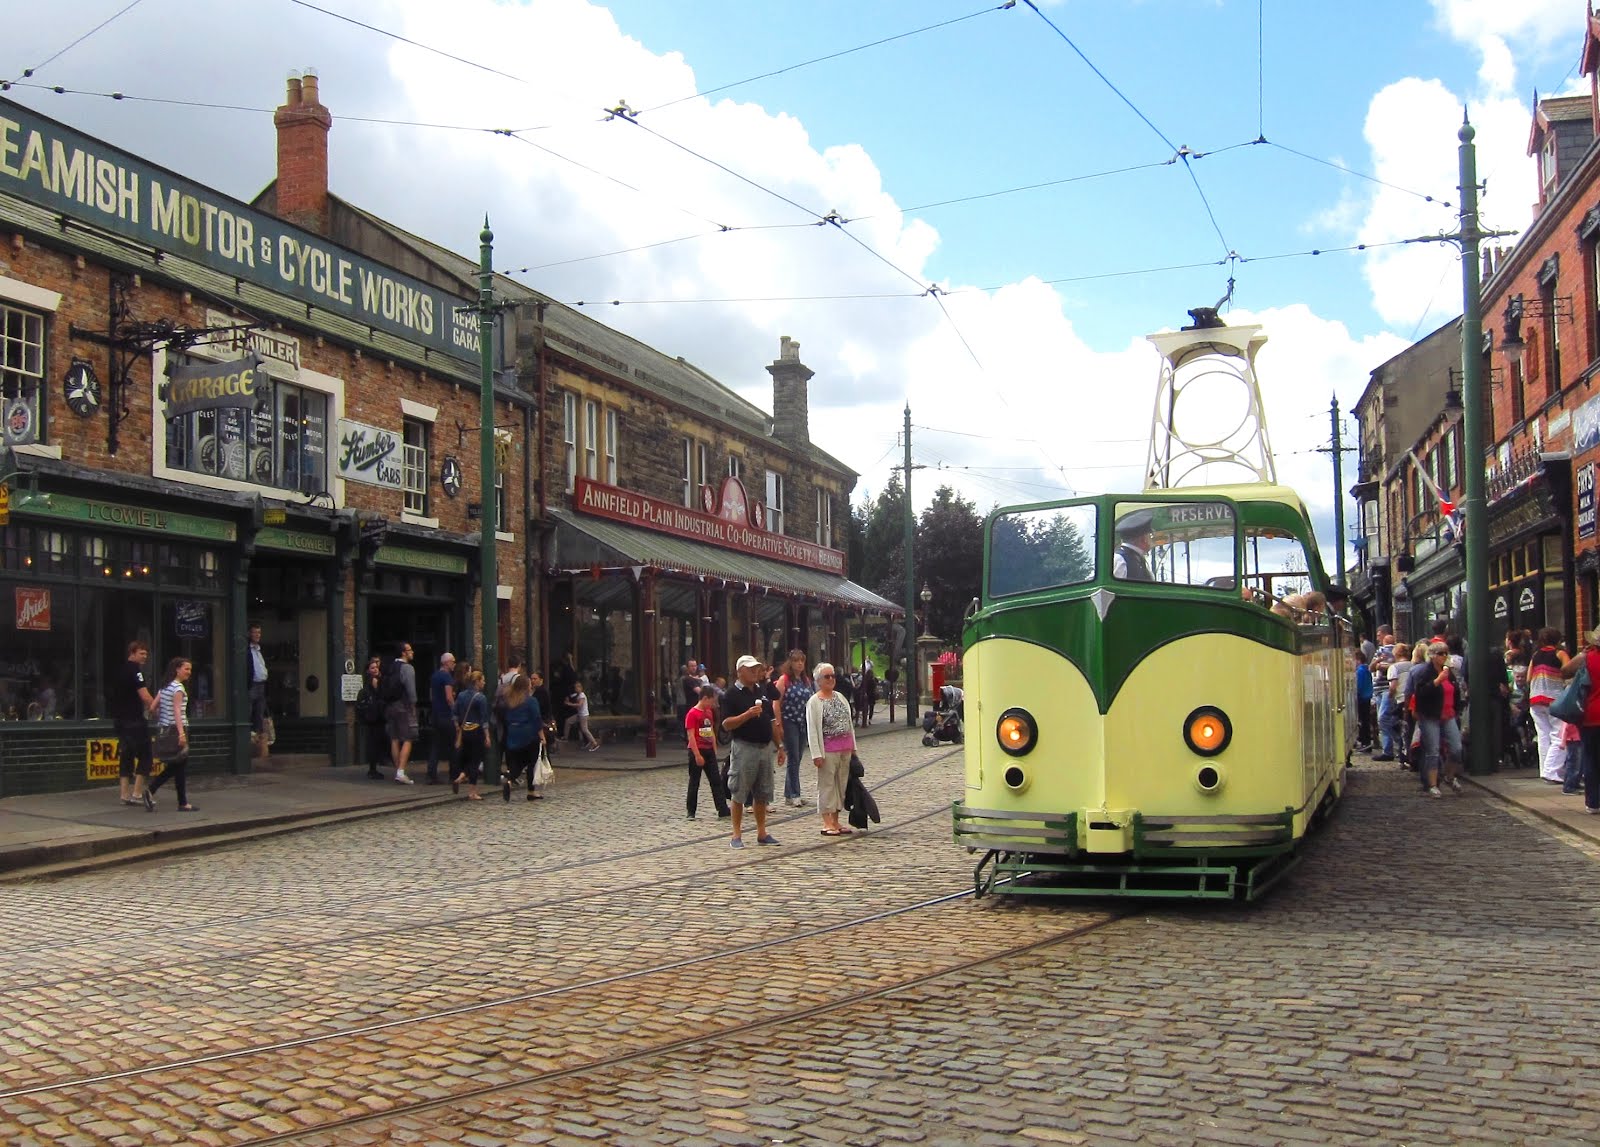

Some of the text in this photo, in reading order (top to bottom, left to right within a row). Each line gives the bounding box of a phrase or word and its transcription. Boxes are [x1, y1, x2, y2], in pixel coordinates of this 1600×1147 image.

[0, 117, 433, 335] EAMISH MOTOR & CYCLE WORKS
[452, 306, 481, 333] REPAI
[236, 329, 294, 363] DAIMLER
[453, 327, 481, 353] GARA
[171, 369, 254, 403] GARAGE
[100, 505, 151, 527] COWIE
[583, 484, 640, 517] ANNFIELD
[642, 500, 672, 526] PLAIN
[675, 510, 724, 540] INDUSTRIAL
[783, 540, 811, 561] SOCIETY
[819, 549, 842, 570] BEAMISH
[90, 764, 120, 777] PERFEC
